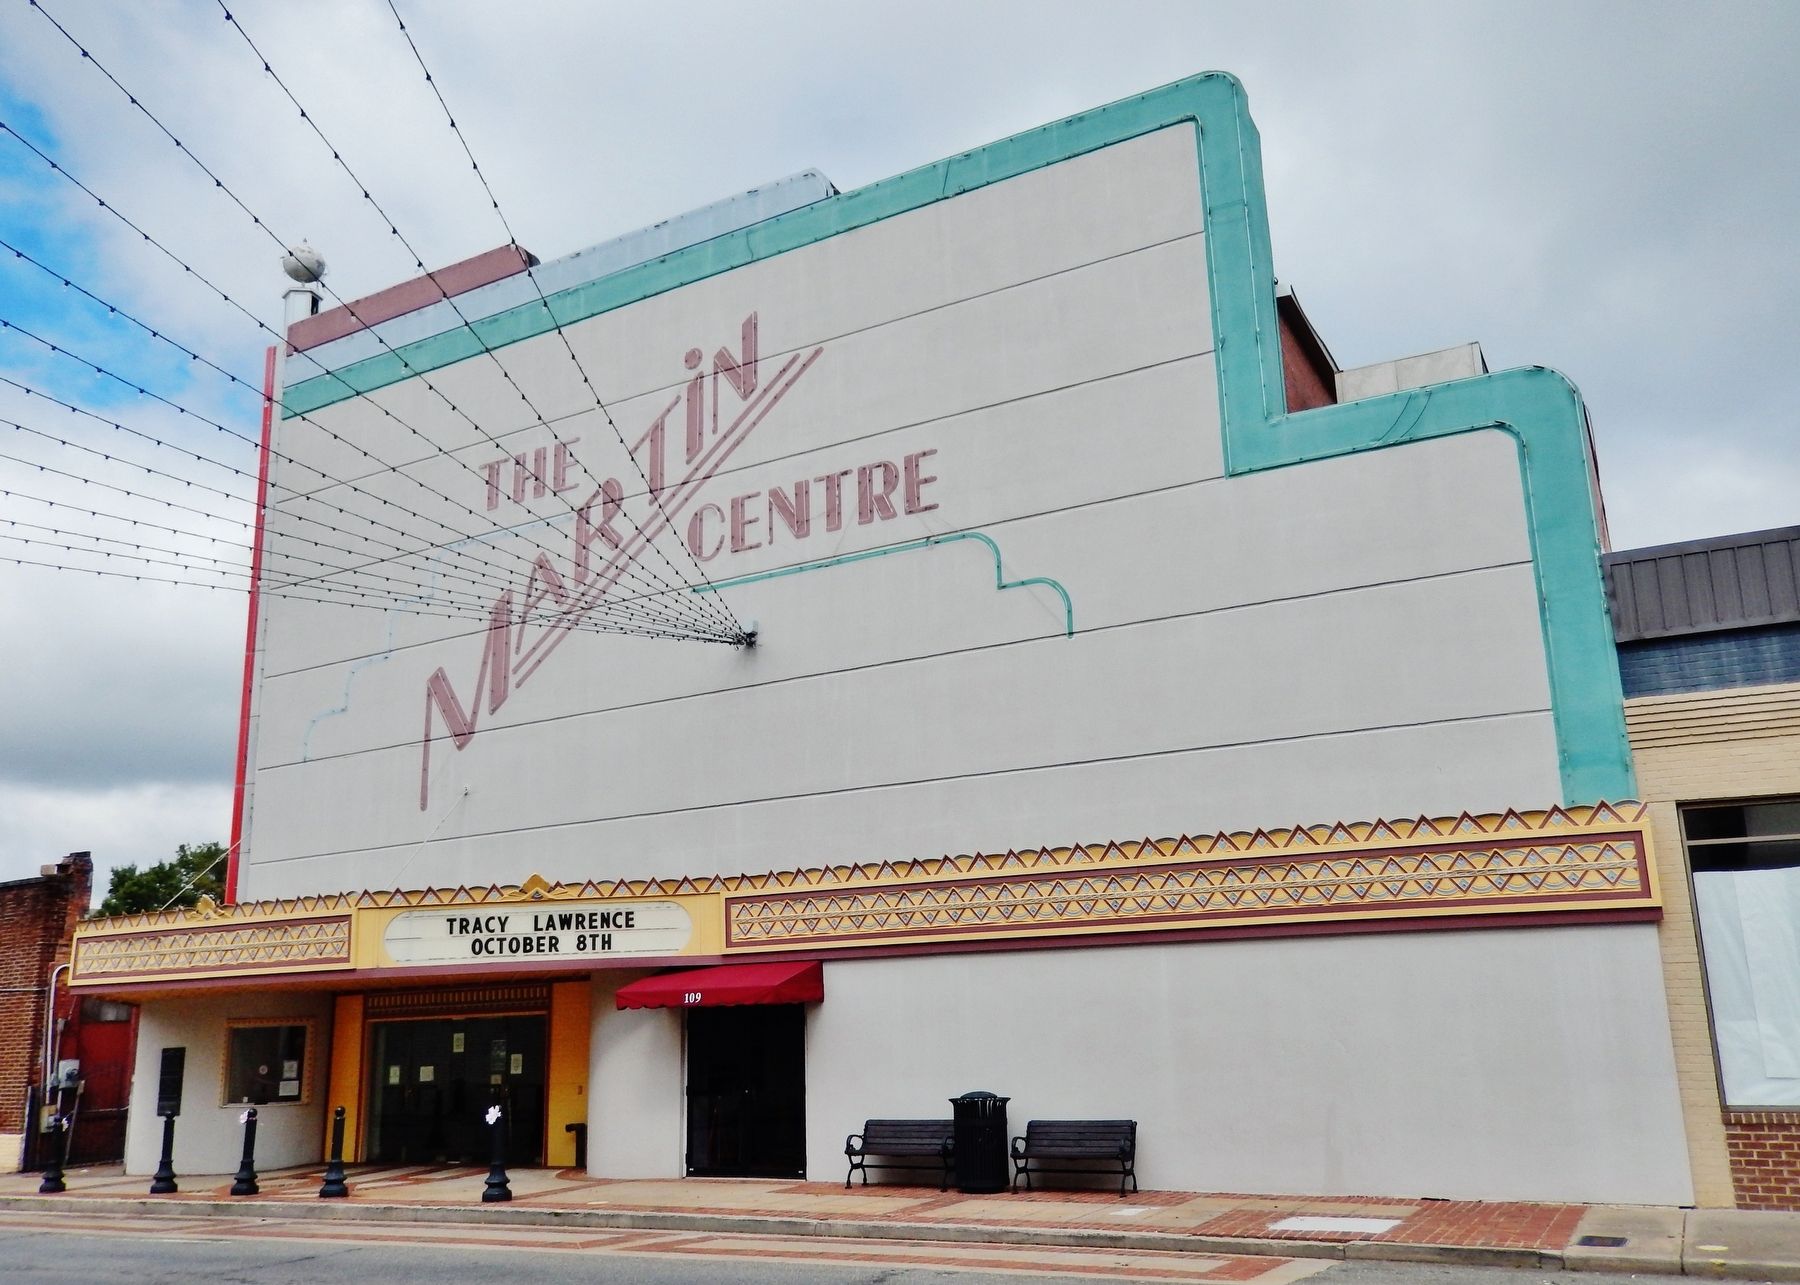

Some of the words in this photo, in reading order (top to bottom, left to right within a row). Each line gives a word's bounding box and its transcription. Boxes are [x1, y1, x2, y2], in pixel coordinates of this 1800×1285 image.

[479, 437, 580, 511] THE
[687, 448, 939, 562] CENTRE
[447, 916, 509, 934] TRACY
[533, 911, 635, 932] LAWRENCE
[470, 935, 560, 956] OCTOBER
[576, 934, 613, 952] 8TH
[683, 992, 702, 1004] 109
